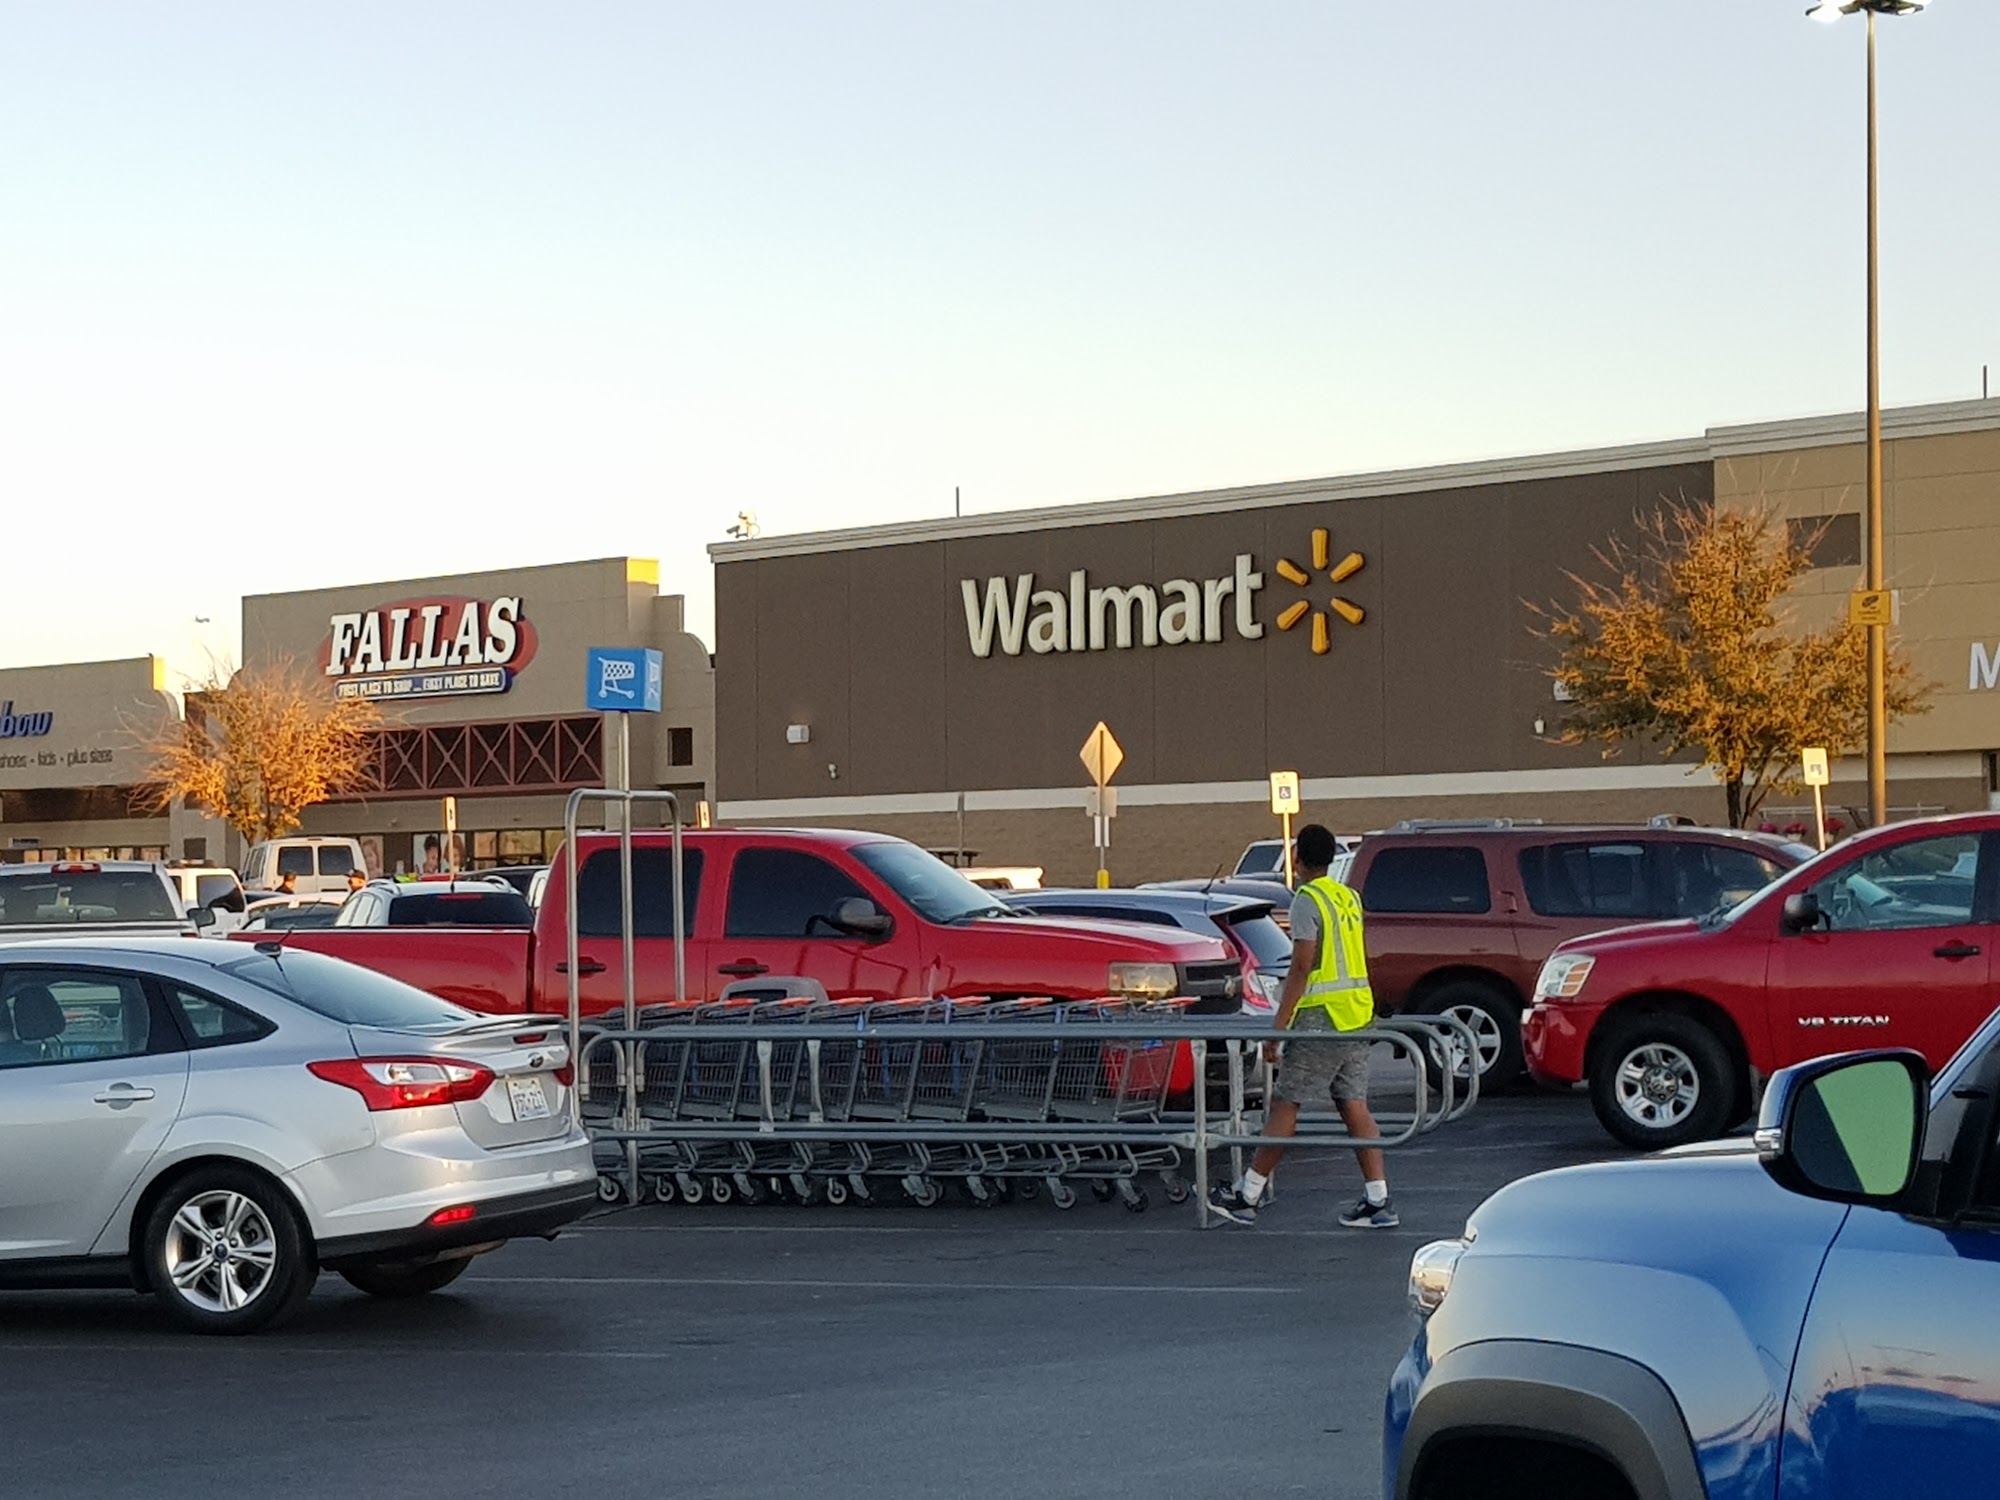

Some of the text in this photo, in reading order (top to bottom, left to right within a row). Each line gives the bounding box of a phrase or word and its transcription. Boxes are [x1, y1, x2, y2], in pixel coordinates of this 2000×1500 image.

[961, 553, 1264, 657] Walmart
[325, 597, 519, 676] FALLAS
[338, 683, 358, 698] FIRST
[360, 681, 381, 695] PLACE
[383, 680, 392, 694] TO
[394, 679, 412, 693] SHOP
[445, 675, 468, 689] PLACE
[469, 674, 478, 688] TO
[480, 672, 500, 687] SAVE
[38, 750, 56, 767] kids
[67, 748, 88, 768] plus
[89, 748, 113, 764] sizes
[1797, 1014, 1890, 1027] V8 TITAN
